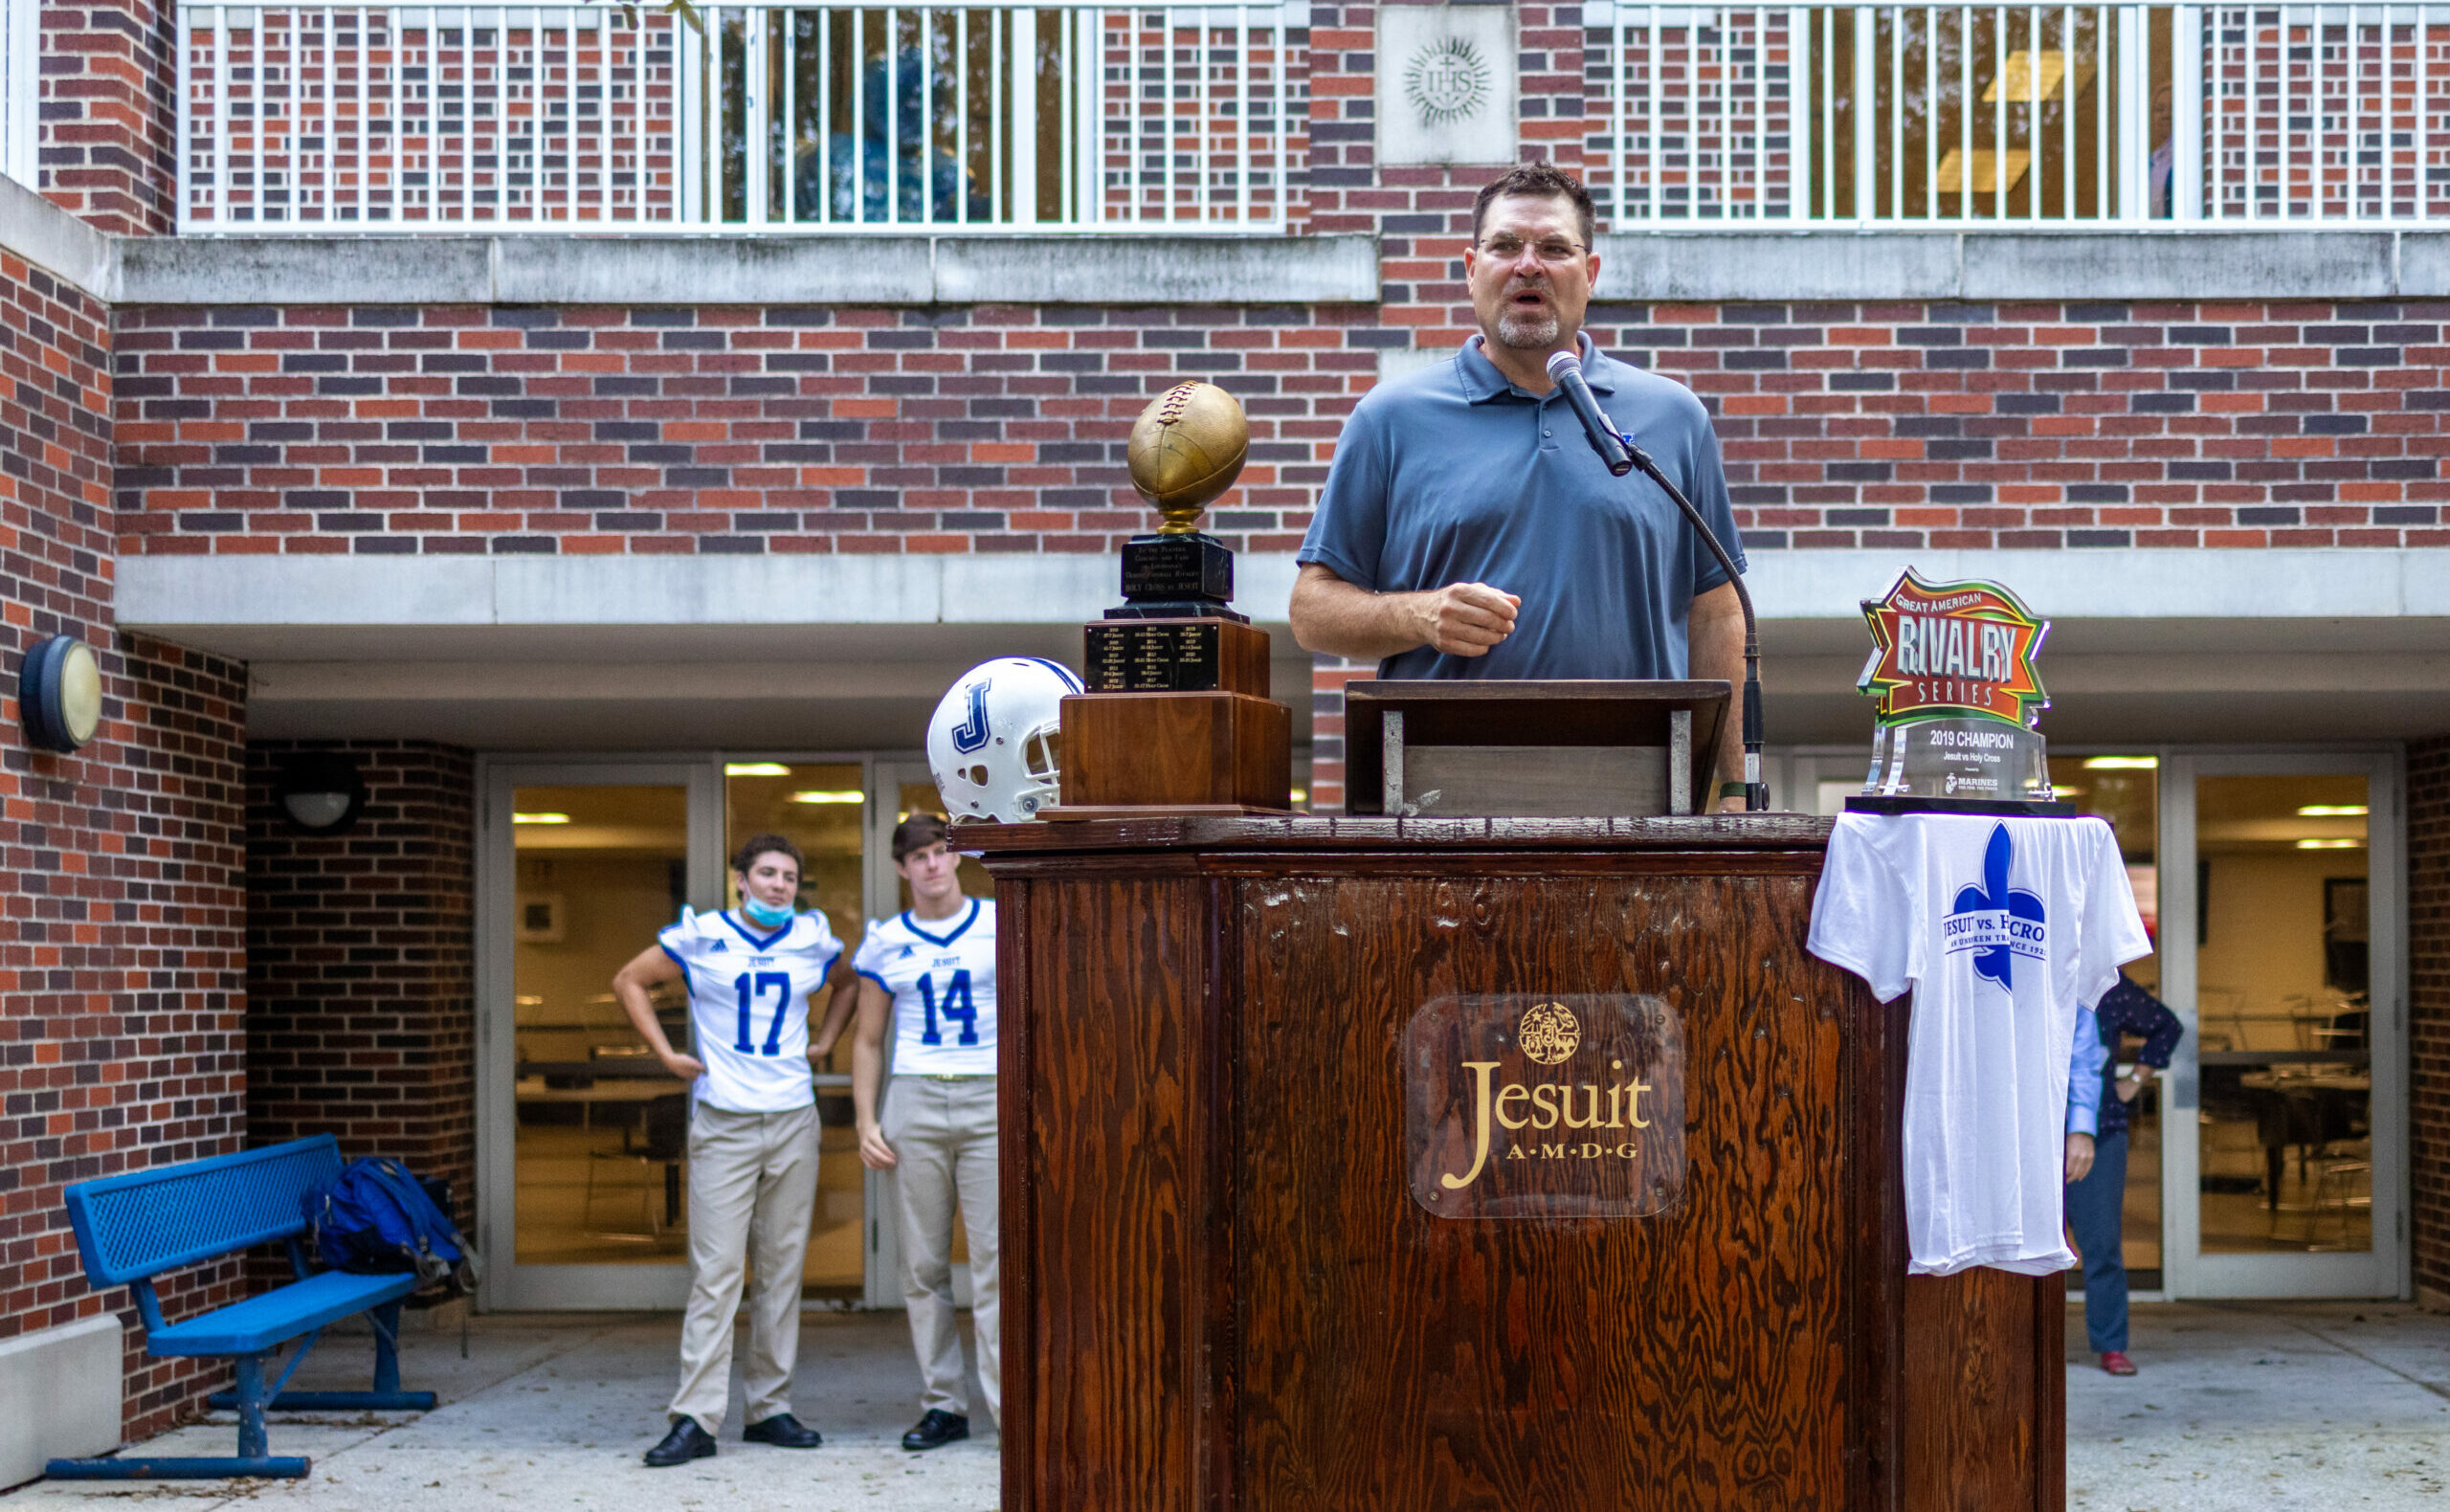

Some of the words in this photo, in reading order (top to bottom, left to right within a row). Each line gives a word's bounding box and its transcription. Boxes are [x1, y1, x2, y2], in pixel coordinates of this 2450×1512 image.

[1427, 70, 1472, 93] IHS
[1895, 593, 1928, 612] GREAT
[1930, 592, 1982, 612] AMERICAN
[1897, 614, 2017, 683] RIVALRY
[1918, 680, 1993, 706] SERIES
[952, 677, 992, 755] J
[1929, 729, 1954, 746] 2019
[1956, 731, 2015, 749] CHAMPION
[1943, 750, 1962, 761] Jesuit
[1970, 752, 1983, 765] Holy
[1983, 753, 2001, 763] Cross
[1958, 777, 1998, 787] MARINES
[734, 971, 791, 1056] 17
[916, 969, 978, 1046] 14
[1441, 1059, 1652, 1190] Jesuit
